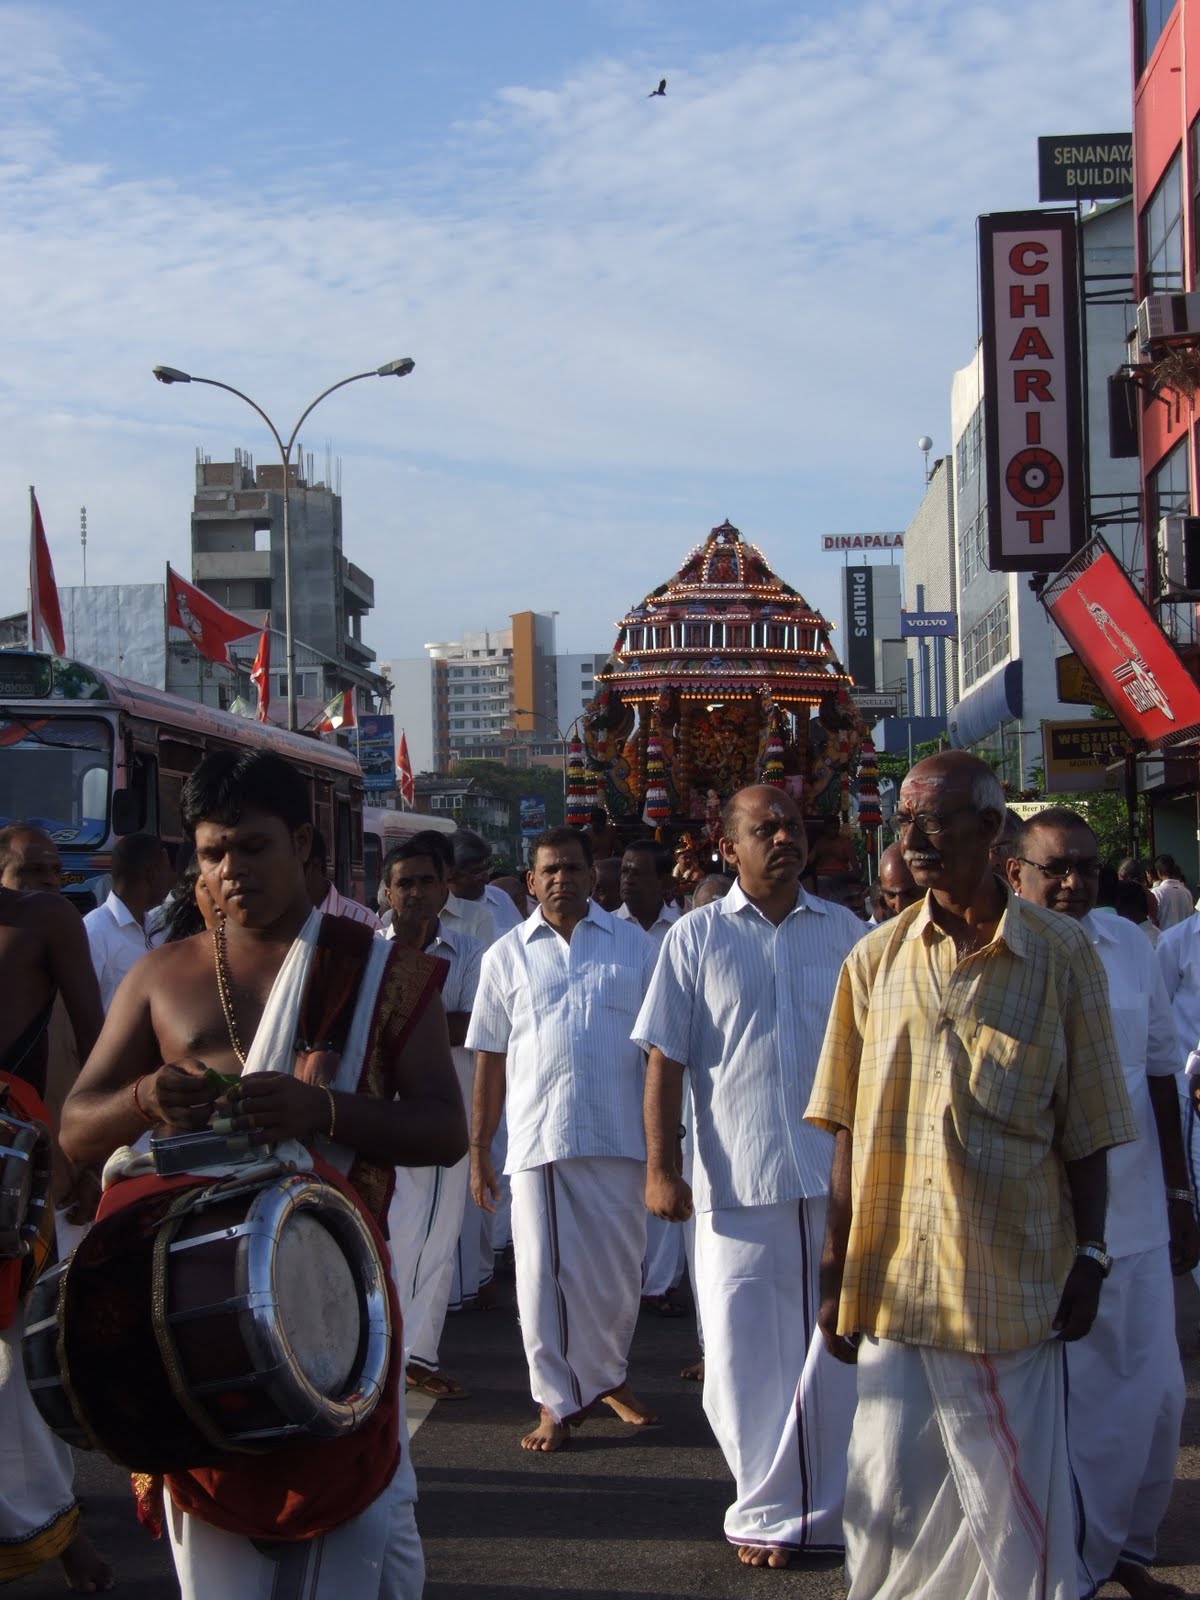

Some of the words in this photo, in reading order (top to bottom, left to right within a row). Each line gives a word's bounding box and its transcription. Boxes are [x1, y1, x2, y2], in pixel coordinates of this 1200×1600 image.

[1066, 168, 1133, 187] BUILDIN
[1005, 242, 1064, 544] CHARIOT
[824, 534, 904, 548] DINAPALA
[853, 572, 868, 637] PHILIPS
[906, 619, 948, 627] VOLVO
[1022, 804, 1038, 812] Beer
